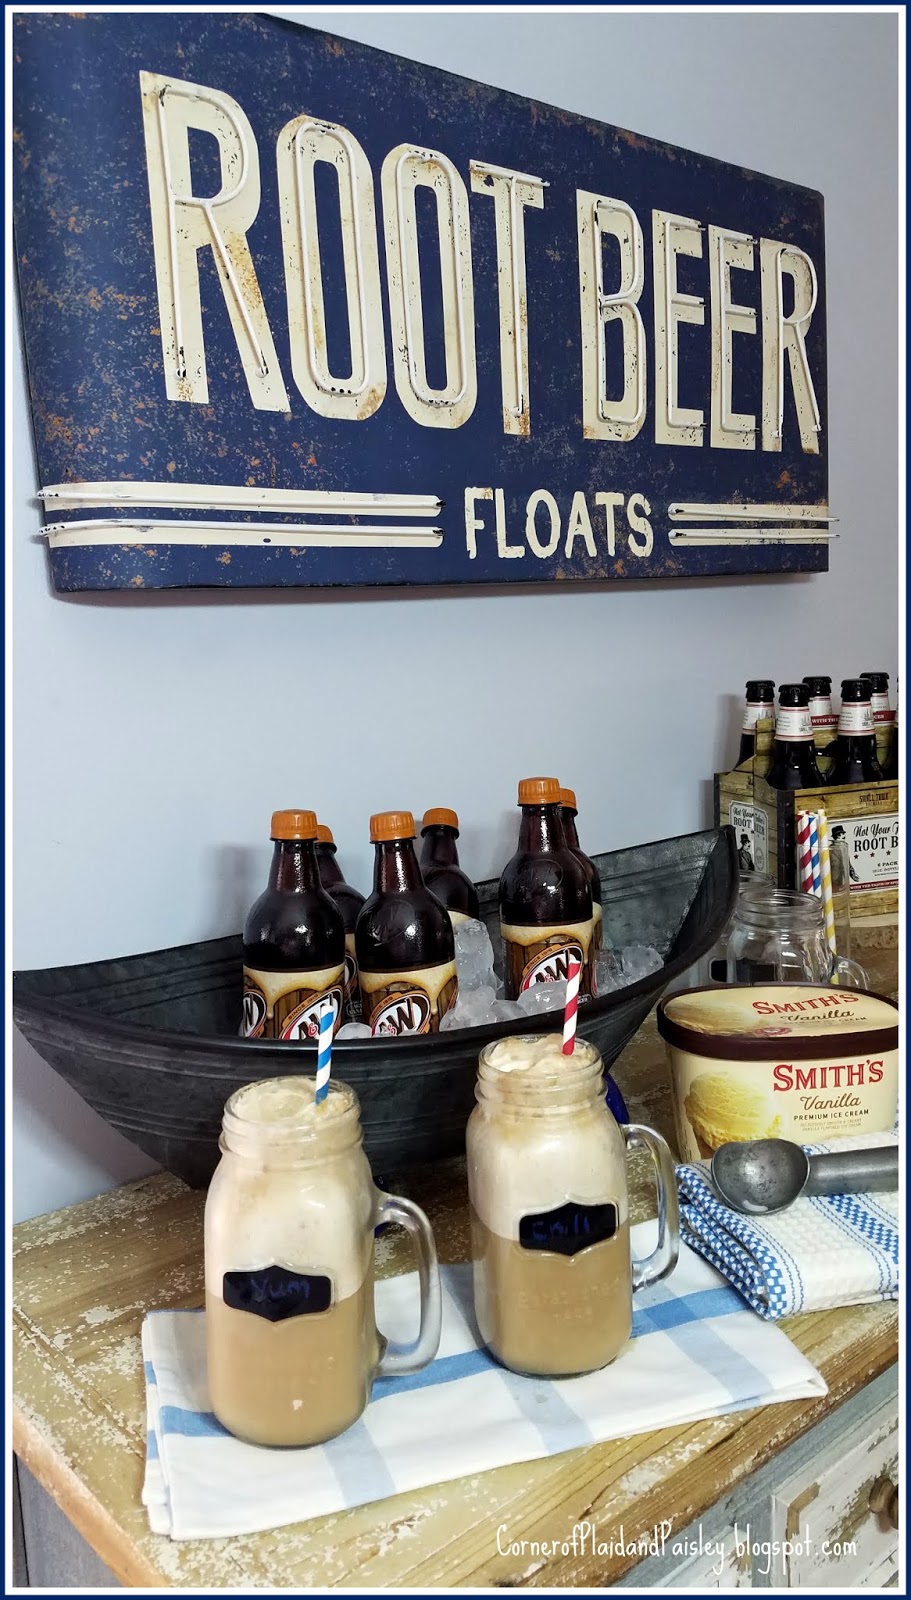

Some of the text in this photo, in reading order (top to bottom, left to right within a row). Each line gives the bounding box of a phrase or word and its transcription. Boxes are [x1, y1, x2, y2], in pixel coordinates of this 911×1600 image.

[139, 70, 821, 454] ROOT BEER
[464, 486, 653, 559] FLOATS
[733, 816, 752, 828] ROOT
[853, 825, 869, 837] Not
[871, 823, 891, 838] Your
[854, 836, 888, 852] ROOT
[752, 993, 859, 1015] SMITH'S
[780, 1009, 855, 1021] Vanilla
[773, 1059, 884, 1092] SMITH'S
[800, 1092, 861, 1110] Vanilla
[794, 1113, 828, 1121] PREMIUM
[845, 1108, 869, 1117] CREAM
